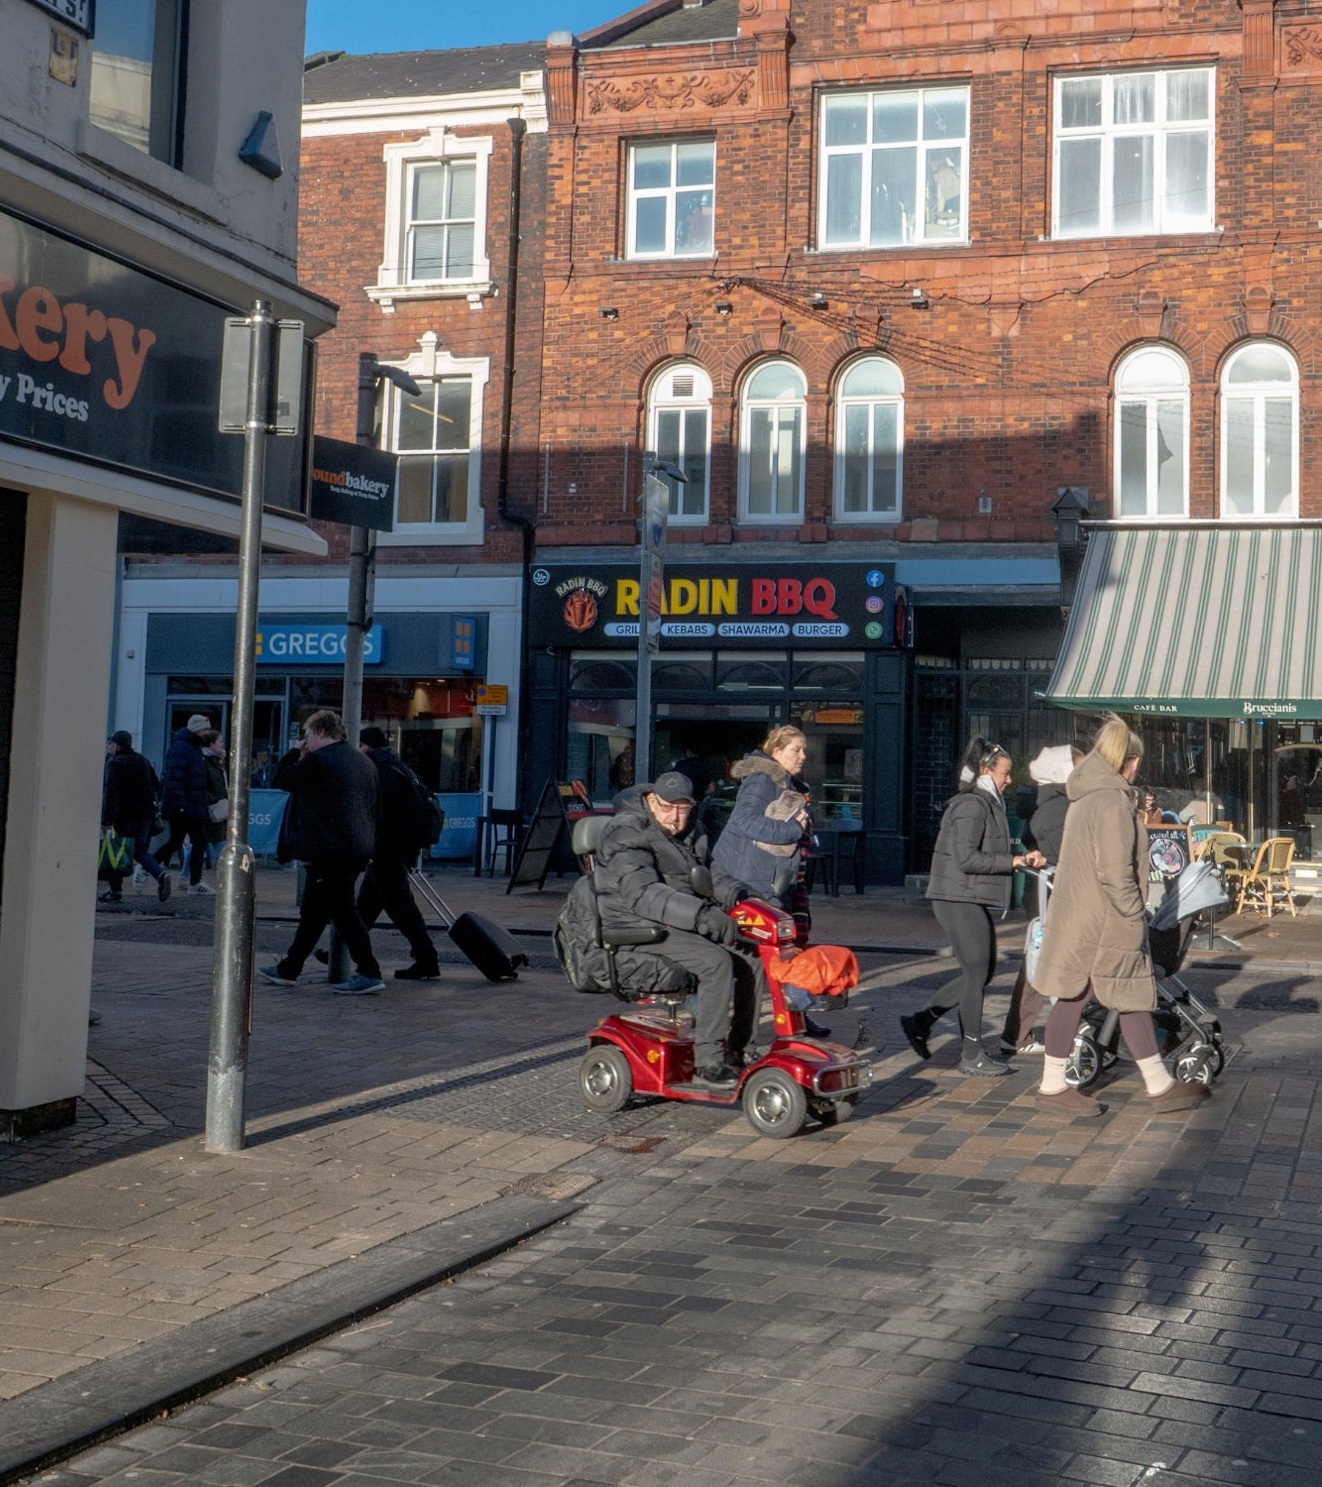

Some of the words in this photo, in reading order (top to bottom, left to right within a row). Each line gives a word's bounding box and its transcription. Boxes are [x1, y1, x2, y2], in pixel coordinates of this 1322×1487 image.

[16, 372, 89, 423] Prices
[313, 469, 390, 498] oundbakery
[556, 577, 586, 596] RADIN
[586, 579, 607, 596] BBQ
[615, 578, 738, 616] RDIN
[751, 578, 839, 620] BBQ
[615, 625, 640, 635] GRIL
[667, 624, 708, 635] KEBABS
[721, 624, 786, 636] SHAWARMA
[798, 625, 843, 636] BURGER
[1133, 703, 1157, 711] CAFÉ
[1243, 701, 1297, 714] Bruccianis
[449, 817, 475, 829] GREGGS
